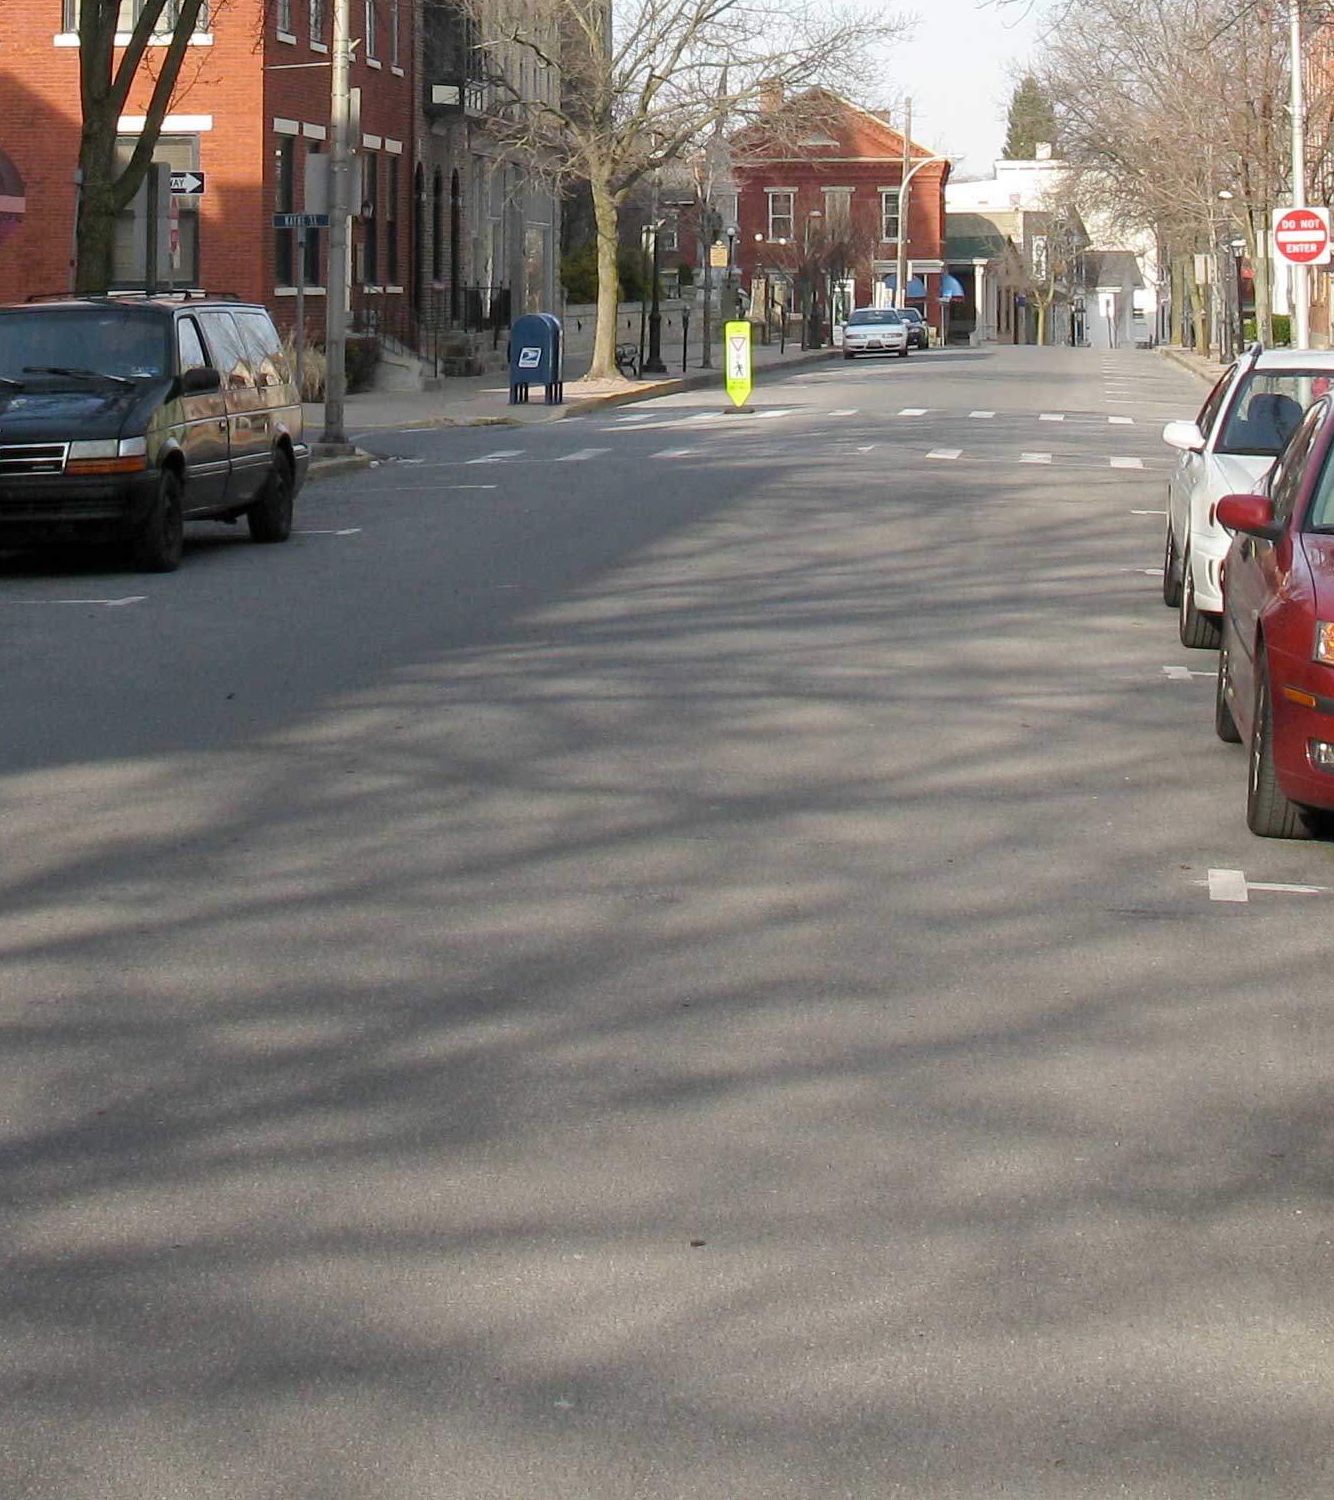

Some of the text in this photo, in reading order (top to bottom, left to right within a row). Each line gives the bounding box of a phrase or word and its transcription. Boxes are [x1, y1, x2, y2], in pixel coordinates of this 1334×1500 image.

[1281, 219, 1320, 229] DO NOT
[1285, 243, 1317, 254] ENTER
